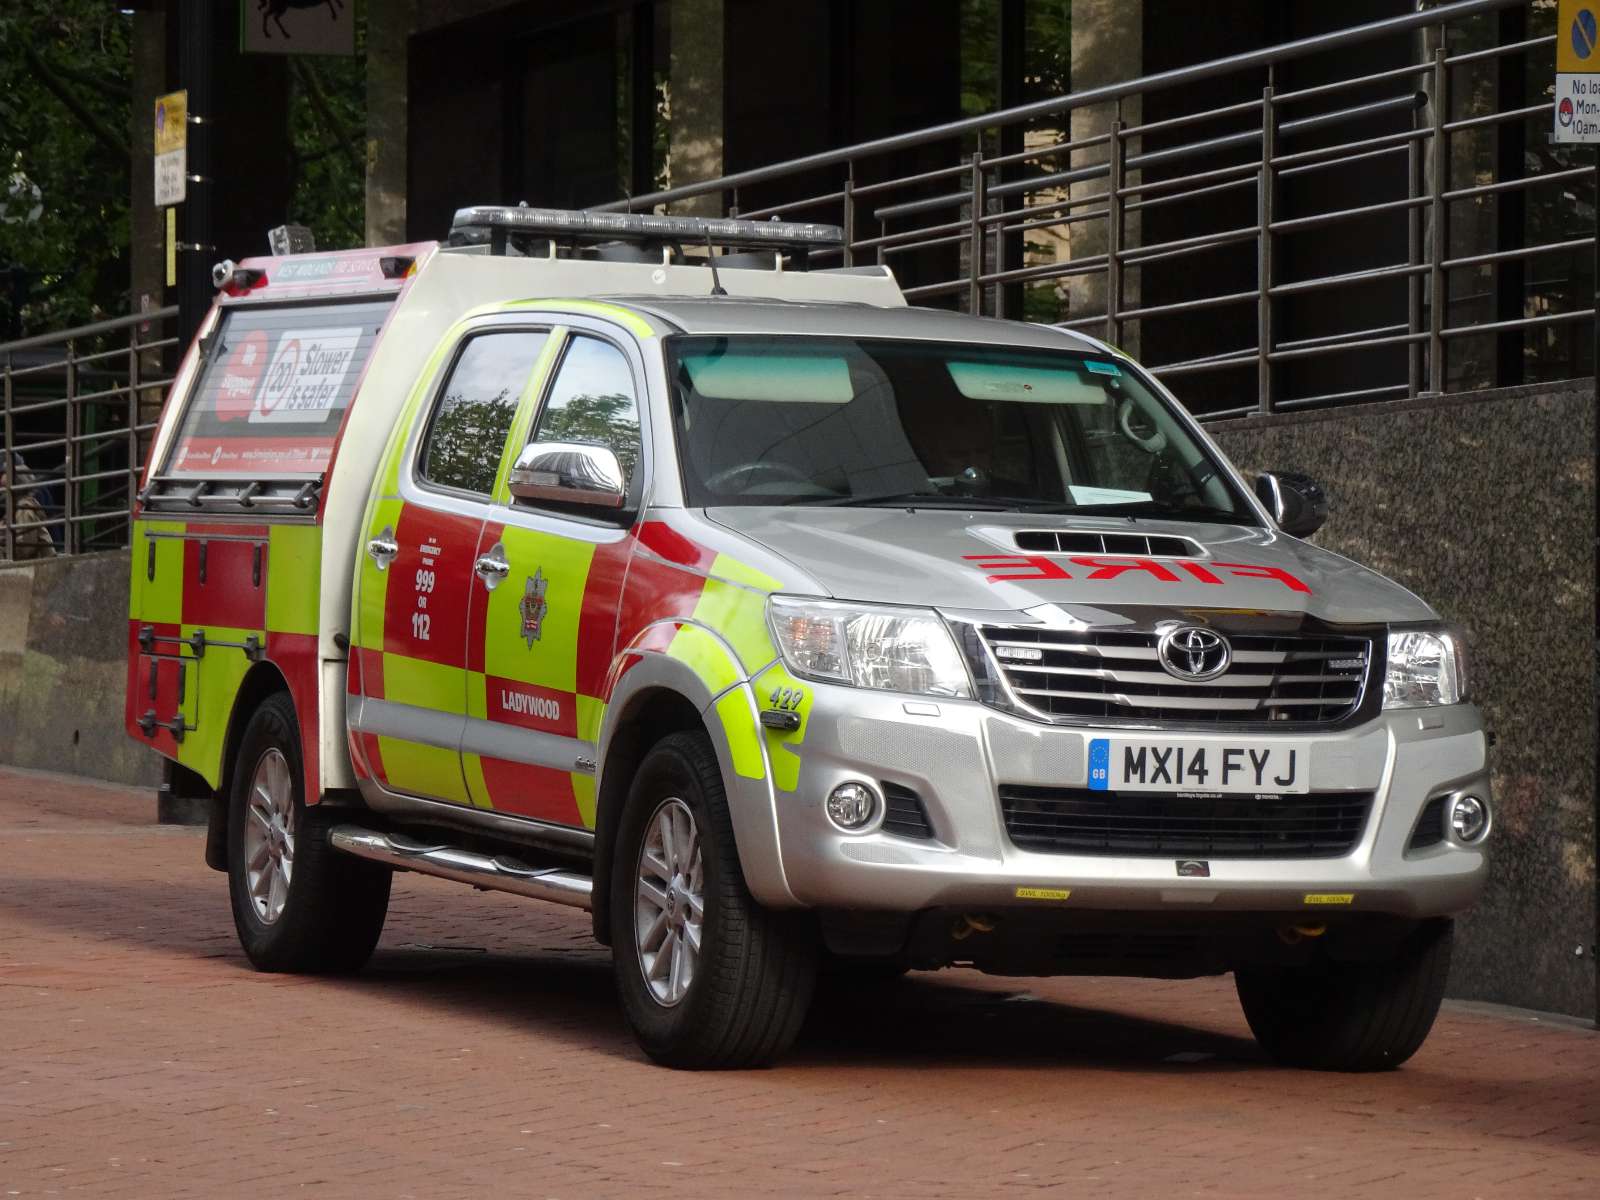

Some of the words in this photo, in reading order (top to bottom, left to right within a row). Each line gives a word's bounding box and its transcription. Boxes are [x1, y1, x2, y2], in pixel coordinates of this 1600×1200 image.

[1573, 80, 1586, 94] No
[300, 344, 350, 375] Slower
[269, 362, 292, 392] 20
[285, 380, 298, 409] is
[295, 378, 336, 409] safer
[415, 569, 435, 593] 999
[418, 595, 427, 609] OR
[412, 612, 431, 640] 112
[502, 689, 560, 720] LADYWOOD
[770, 687, 803, 710] 429
[1092, 768, 1106, 779] GB
[1124, 746, 1209, 785] MX14
[1222, 748, 1296, 787] FYJ
